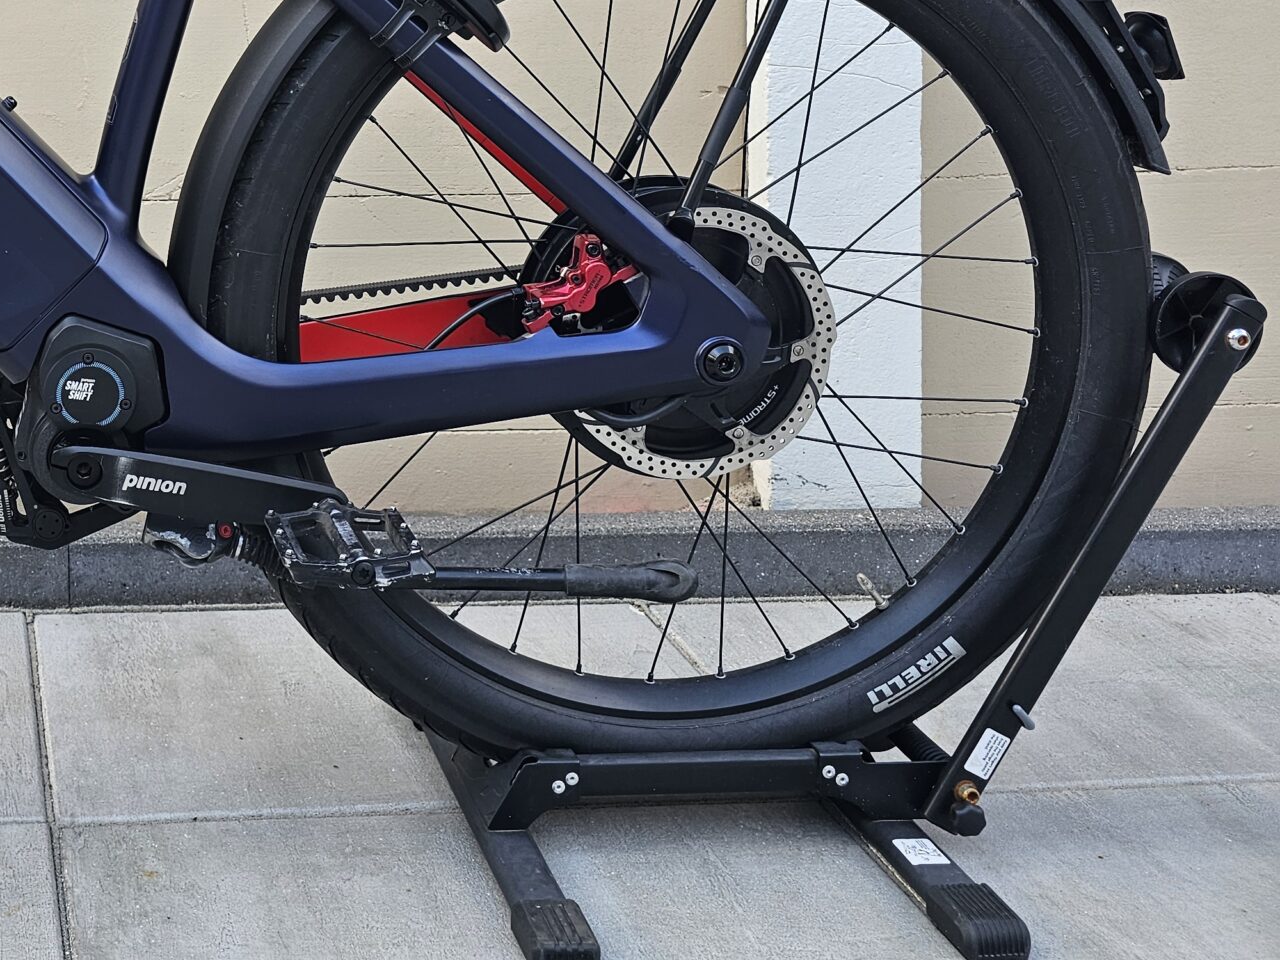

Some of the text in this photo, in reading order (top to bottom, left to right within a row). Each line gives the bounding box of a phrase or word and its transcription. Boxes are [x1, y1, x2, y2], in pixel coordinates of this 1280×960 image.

[68, 390, 93, 401] SHIFT
[121, 473, 187, 495] pinion
[866, 635, 967, 713] PIRELLI
